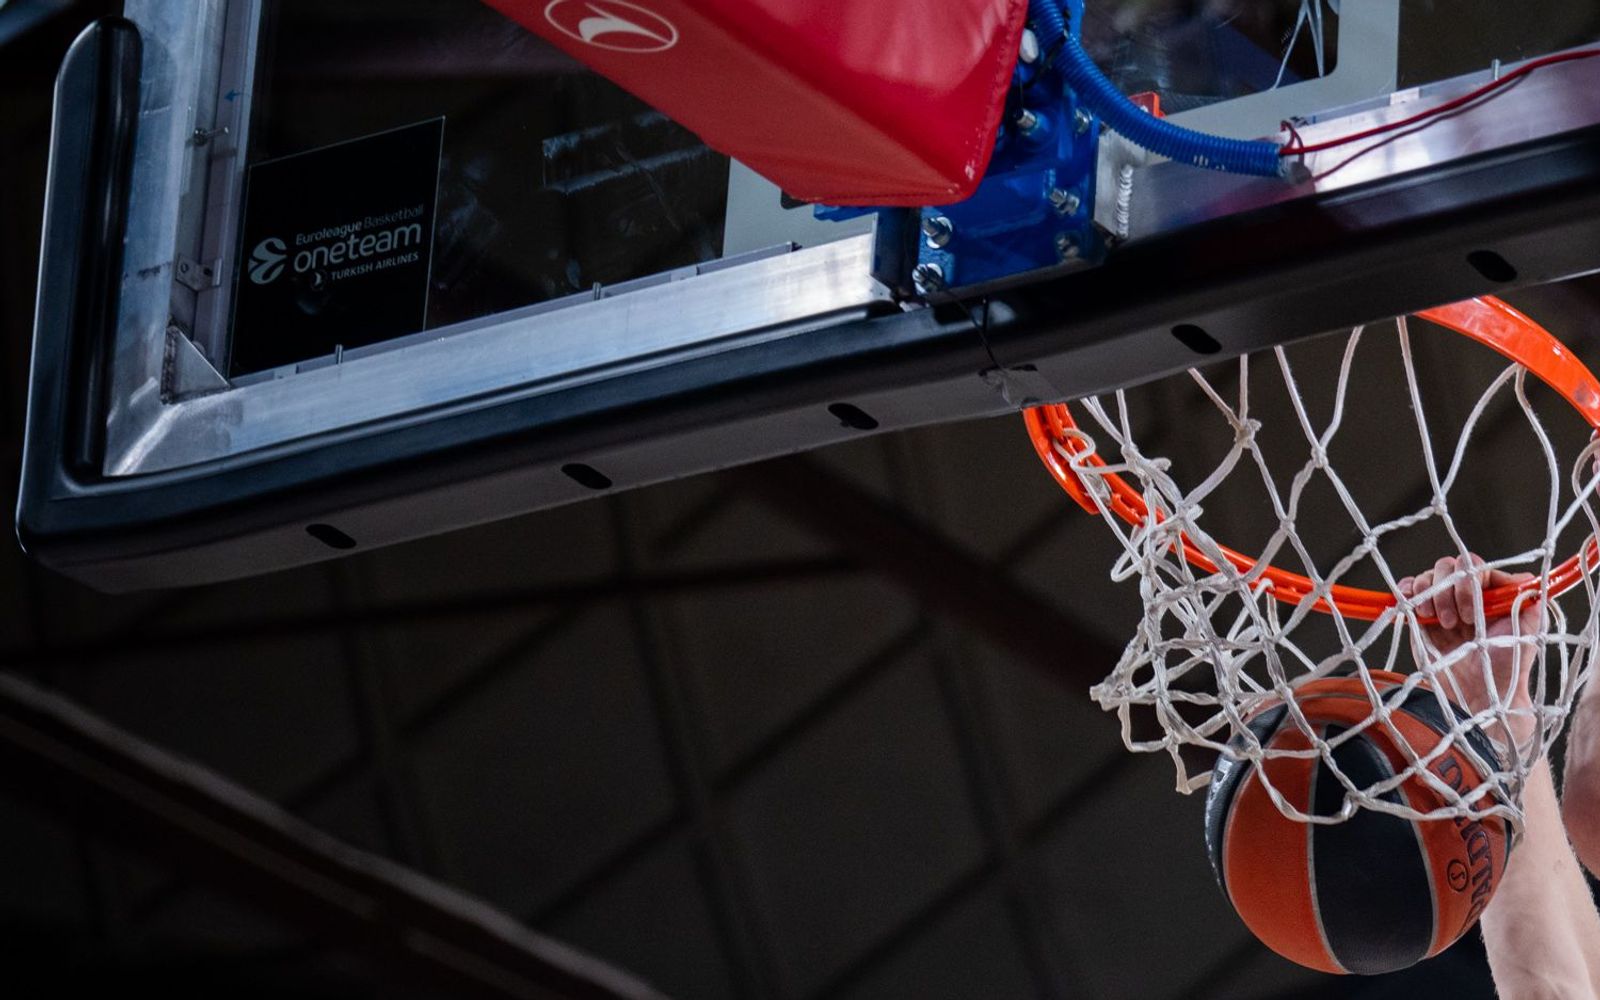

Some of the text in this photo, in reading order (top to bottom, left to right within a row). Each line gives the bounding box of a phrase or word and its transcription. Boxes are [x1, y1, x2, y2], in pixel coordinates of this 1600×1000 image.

[296, 205, 424, 245] Euroleague Basketball
[294, 223, 421, 273] oneteam
[331, 251, 419, 281] TURKISH AIRLINES
